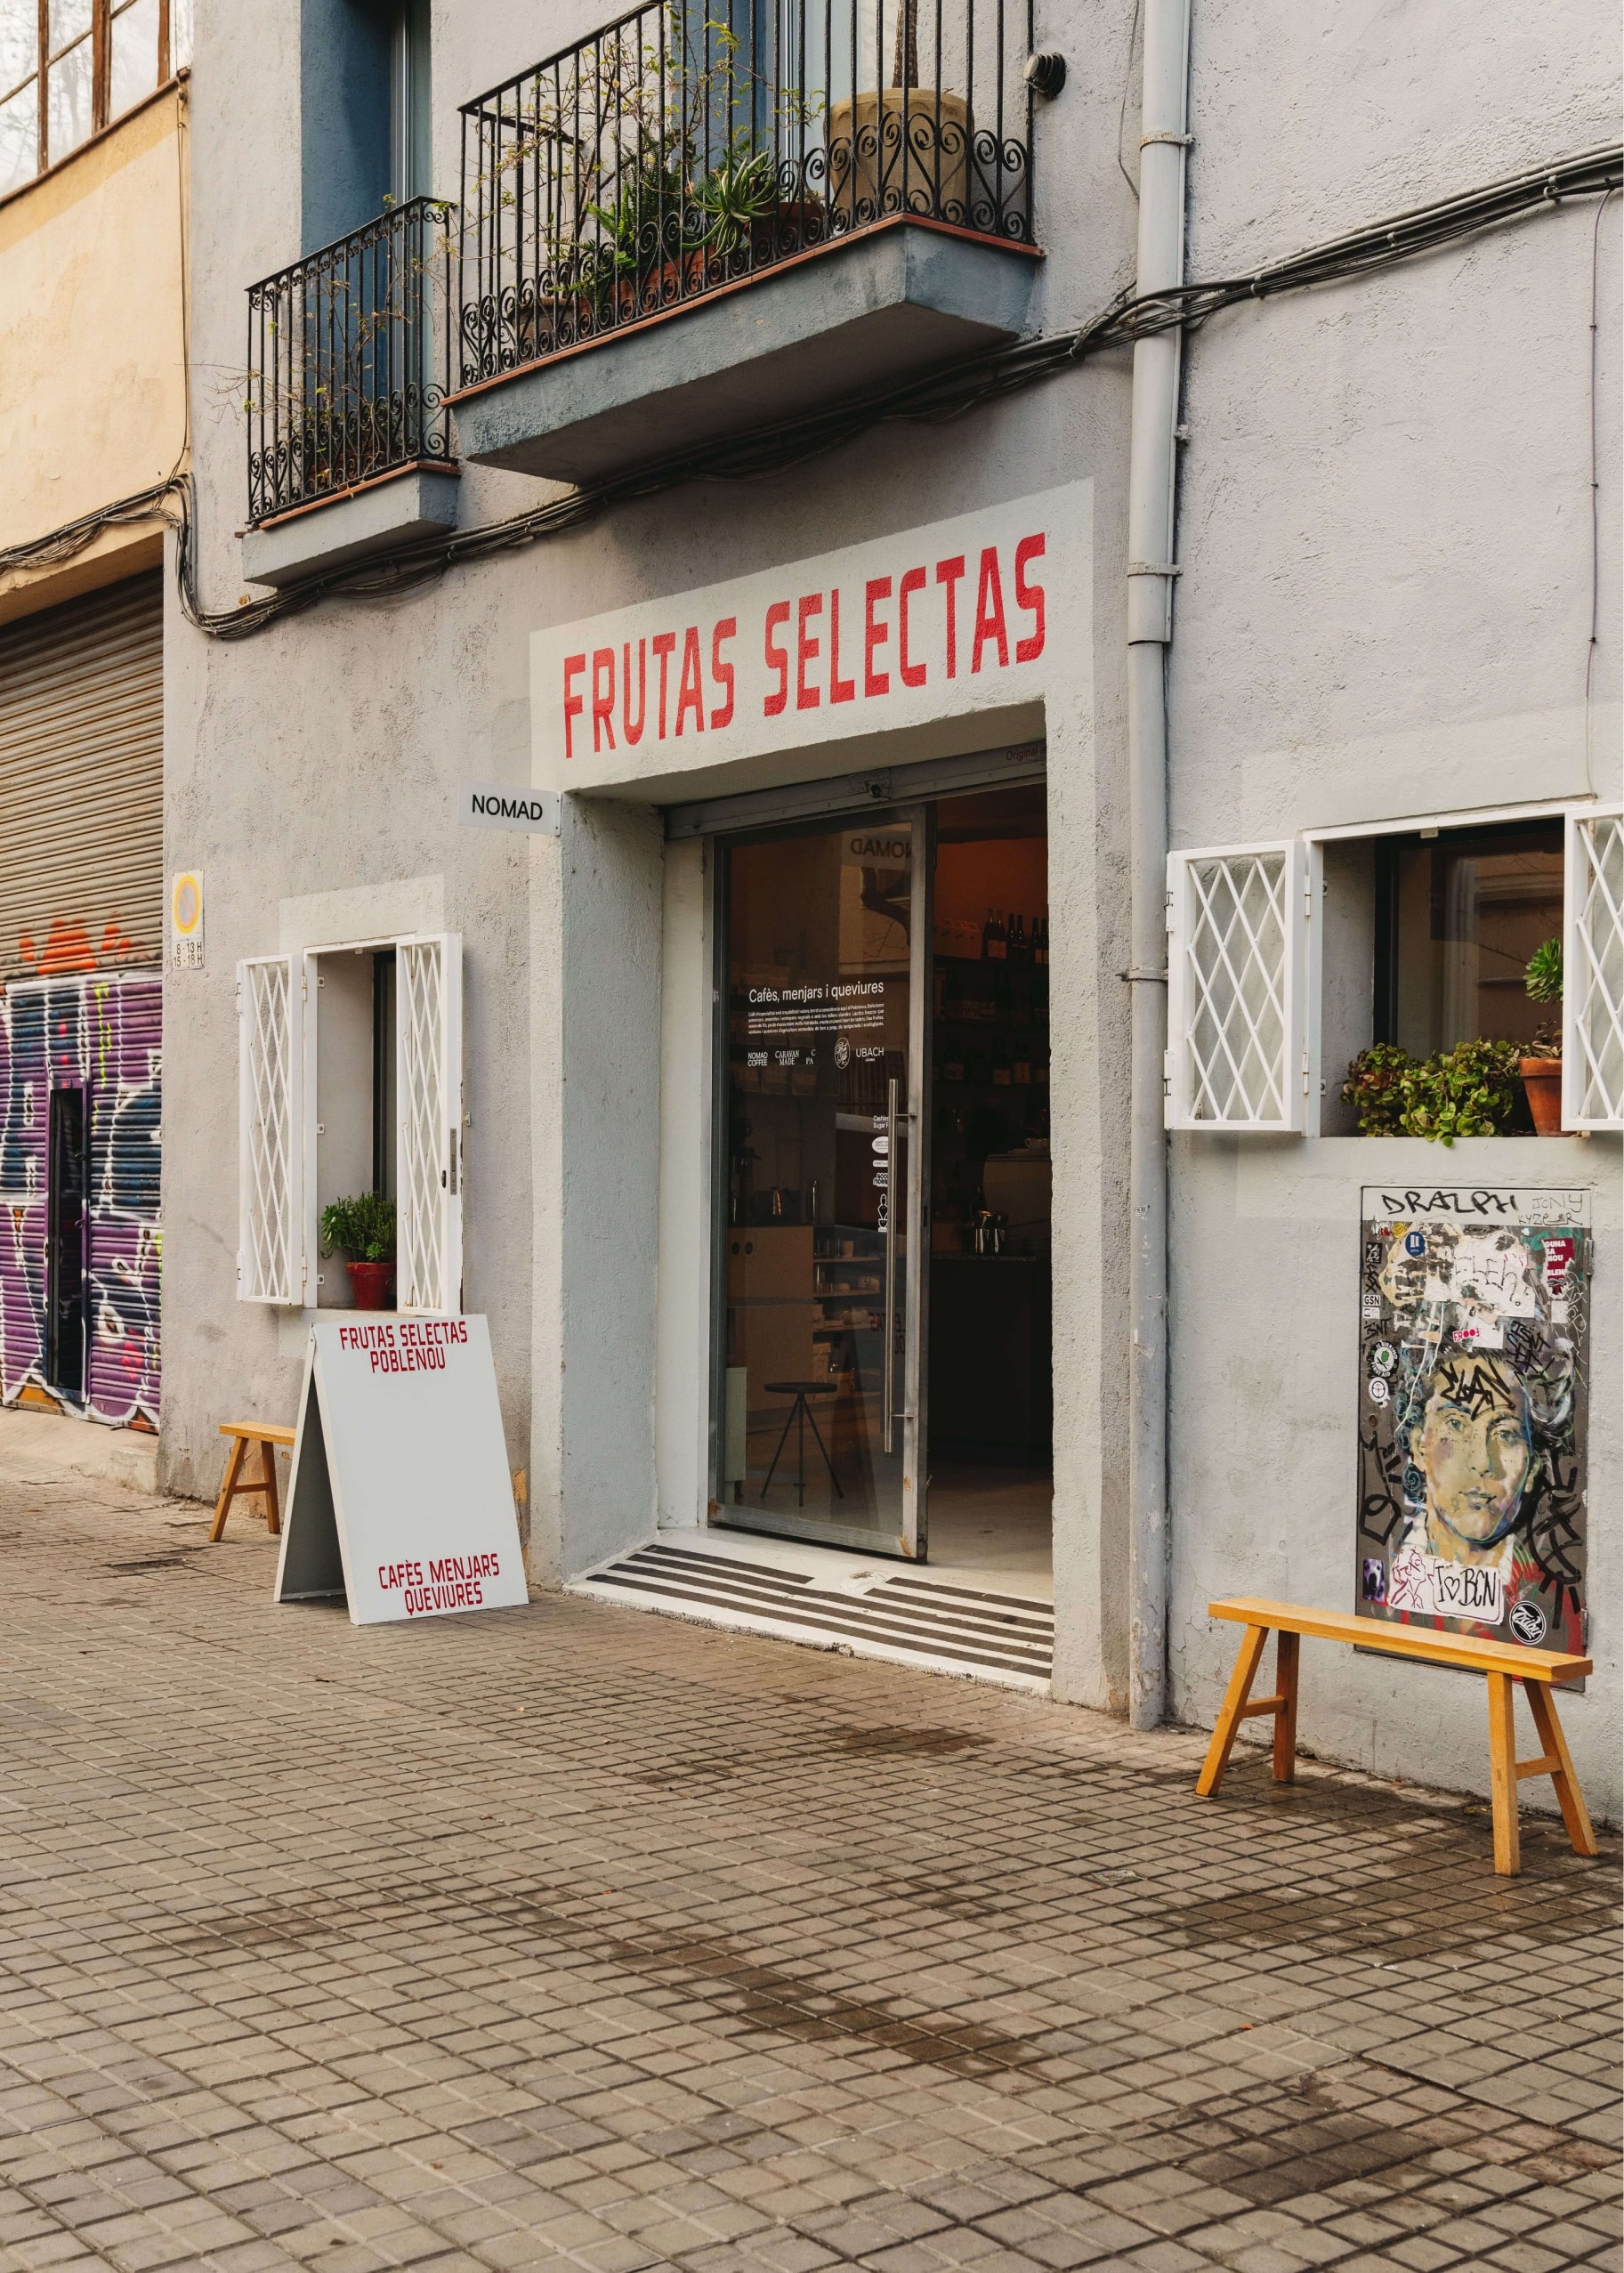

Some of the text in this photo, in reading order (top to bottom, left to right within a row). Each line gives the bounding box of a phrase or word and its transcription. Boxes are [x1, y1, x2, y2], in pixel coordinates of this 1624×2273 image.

[563, 532, 1046, 758] FRUTAS SELECTAS
[1006, 745, 1038, 762] Original
[472, 794, 543, 821] NOMAD
[748, 981, 884, 1003] Cafès, menjars i queviures
[747, 1051, 768, 1060] NOMAD
[747, 1059, 768, 1067] COFFEE
[774, 1049, 800, 1058] CARAVAN
[780, 1057, 796, 1065] MADE
[855, 1047, 885, 1058] UBACH
[1364, 1295, 1380, 1305] GSN
[339, 1321, 468, 1351] FRUTAS SELECTAS
[369, 1347, 446, 1373] POBLENOU
[378, 1553, 500, 1589] CAFÈS MENJARS
[1458, 1568, 1497, 1606] BCN
[404, 1581, 483, 1616] QUEVIURES
